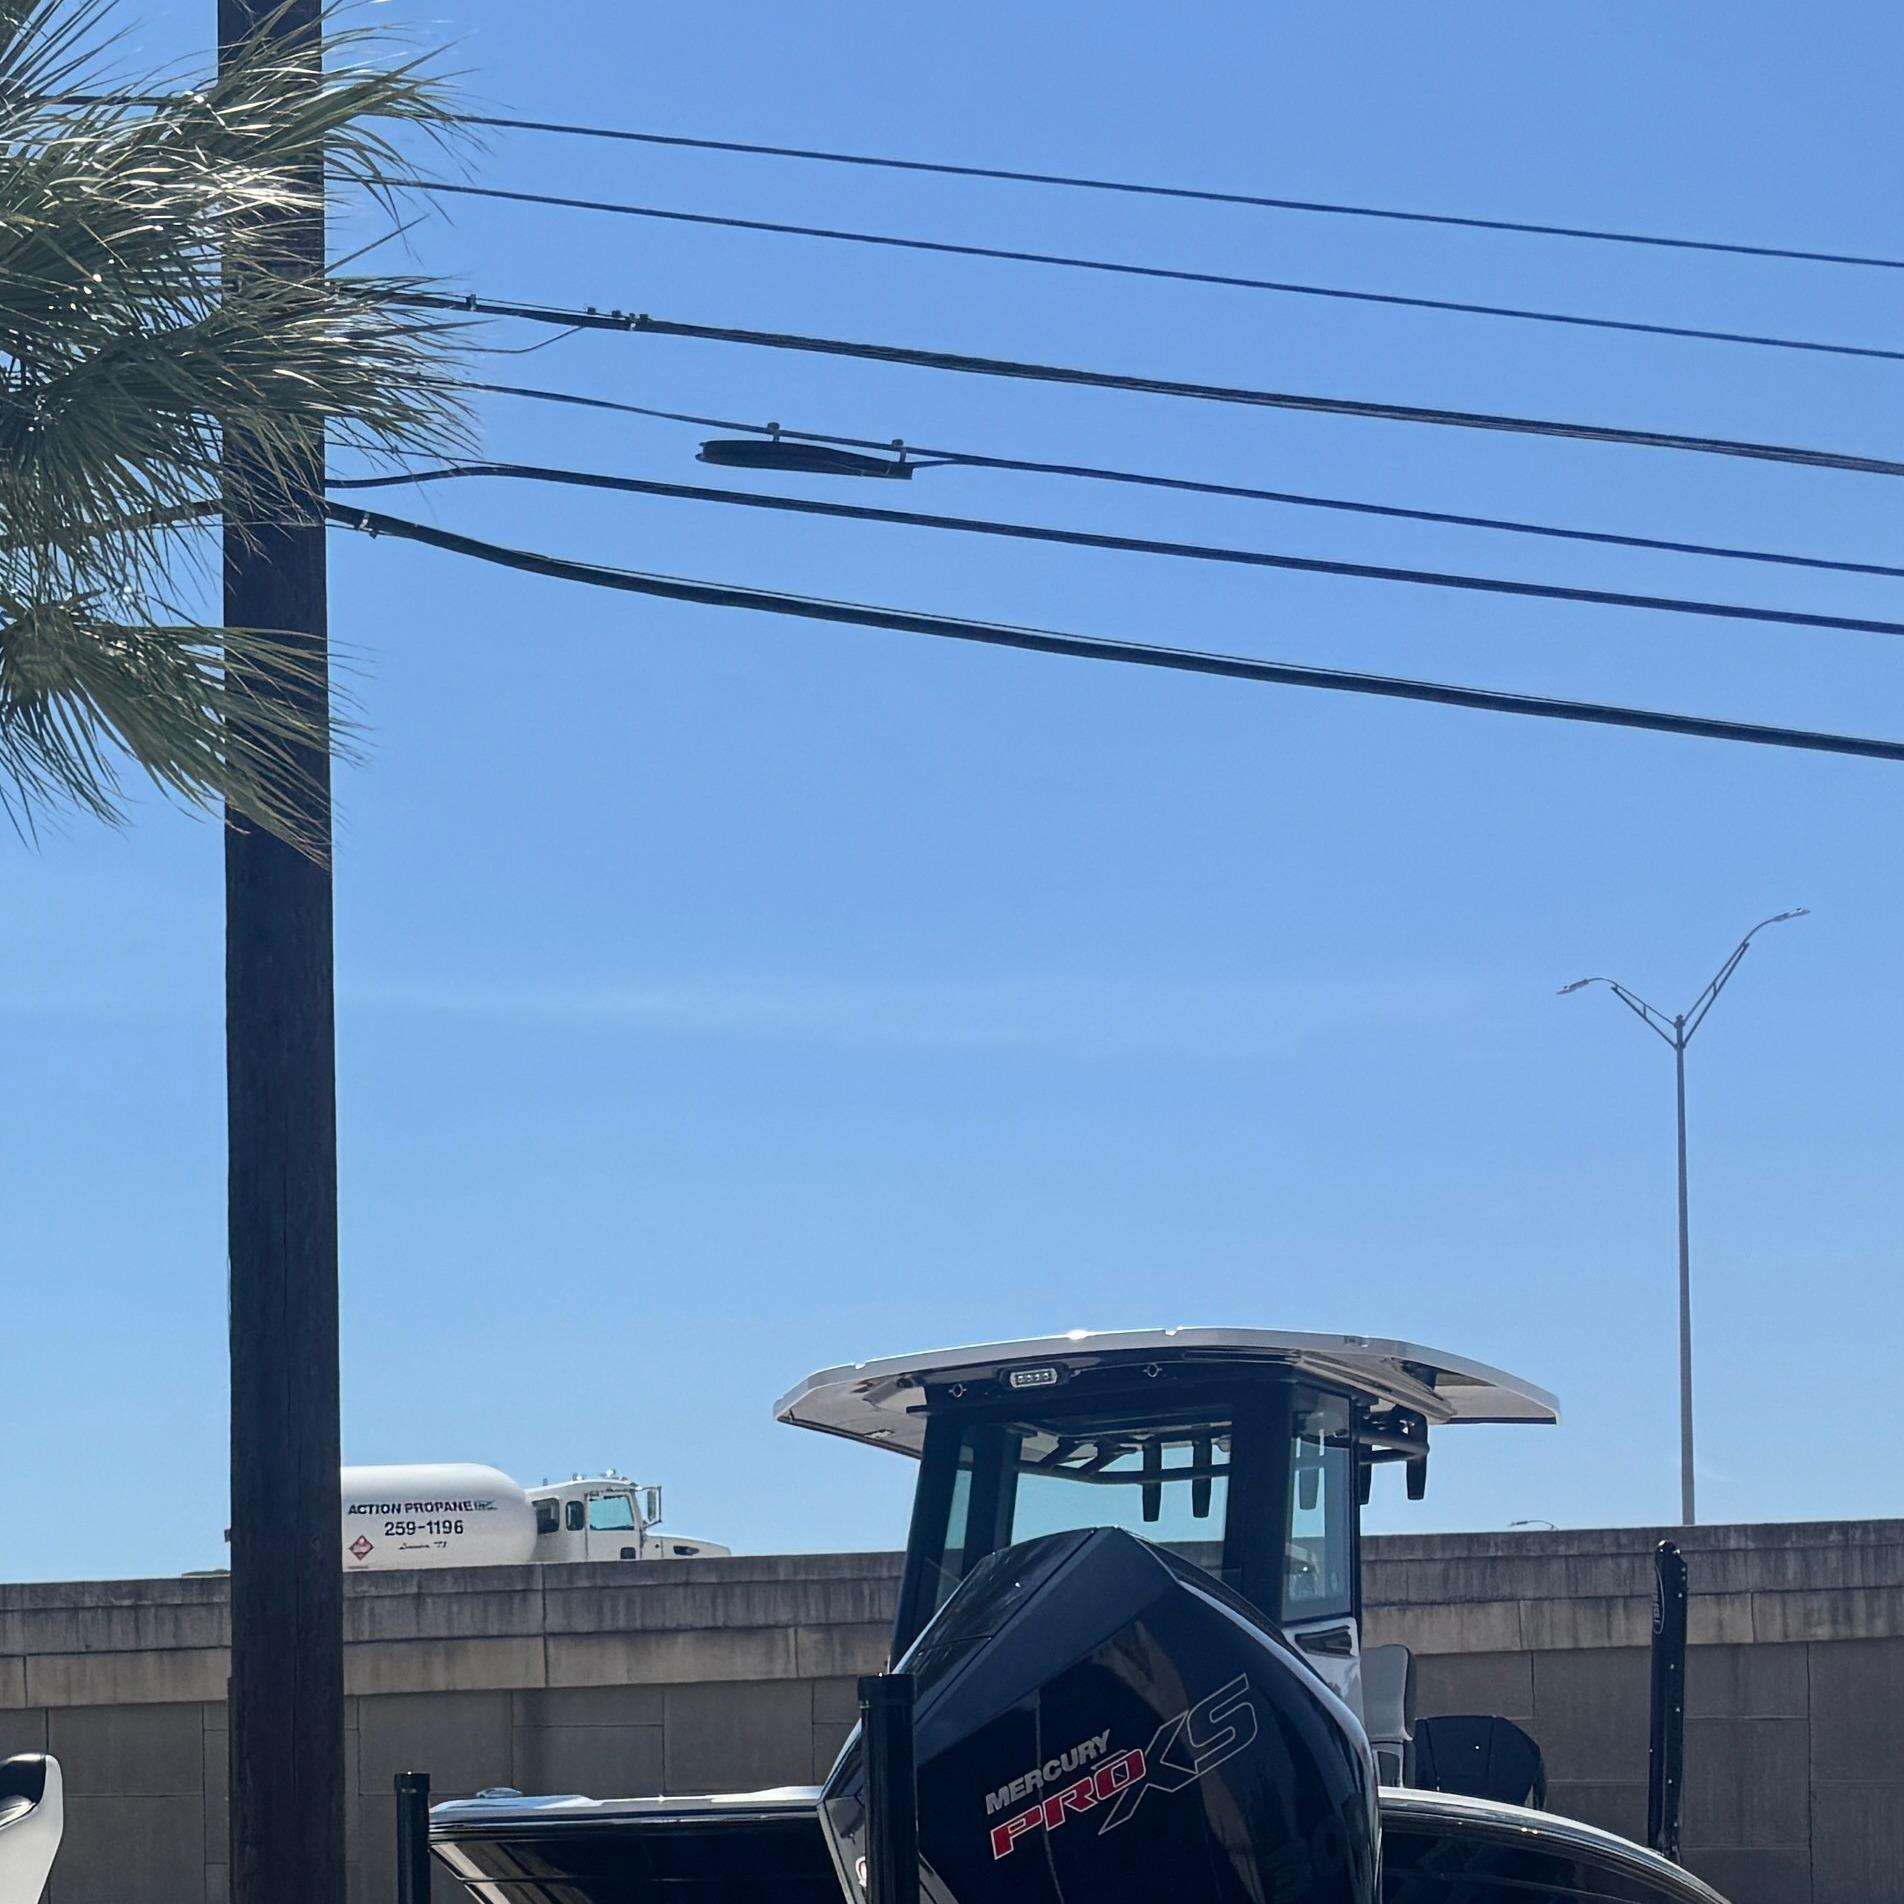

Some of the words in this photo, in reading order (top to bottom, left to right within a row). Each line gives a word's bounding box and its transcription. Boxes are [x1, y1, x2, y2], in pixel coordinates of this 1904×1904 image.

[347, 1503, 402, 1515] ACTION
[404, 1501, 473, 1513] PROPANE
[384, 1520, 464, 1536] 259-1196
[986, 1729, 1111, 1815] MERCURY
[990, 1749, 1147, 1860] PRO
